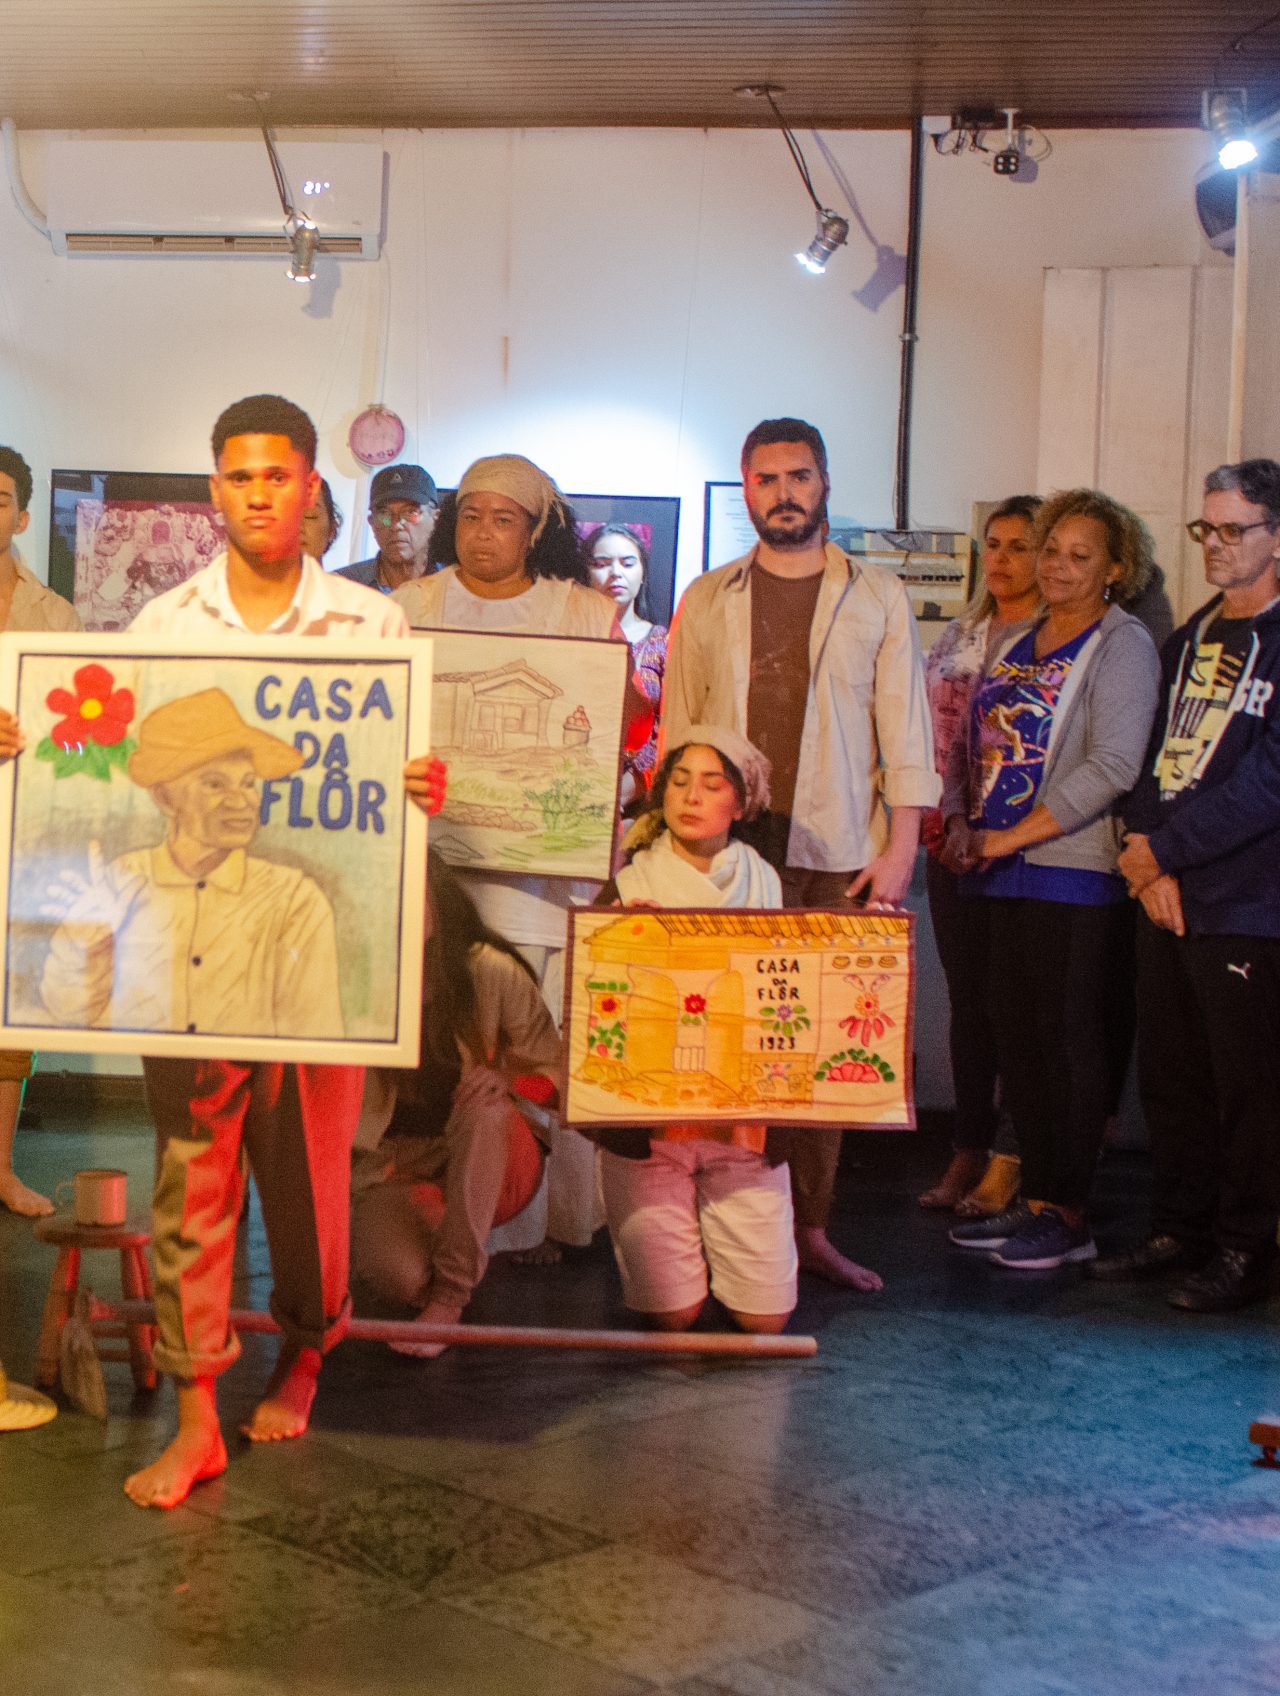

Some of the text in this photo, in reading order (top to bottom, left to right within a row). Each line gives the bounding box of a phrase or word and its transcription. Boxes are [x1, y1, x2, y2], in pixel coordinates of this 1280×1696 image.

[255, 675, 393, 722] CASA
[293, 731, 349, 769] DA
[260, 768, 387, 834] FLÔR
[757, 959, 800, 974] CASA
[759, 1036, 796, 1051] 1923
